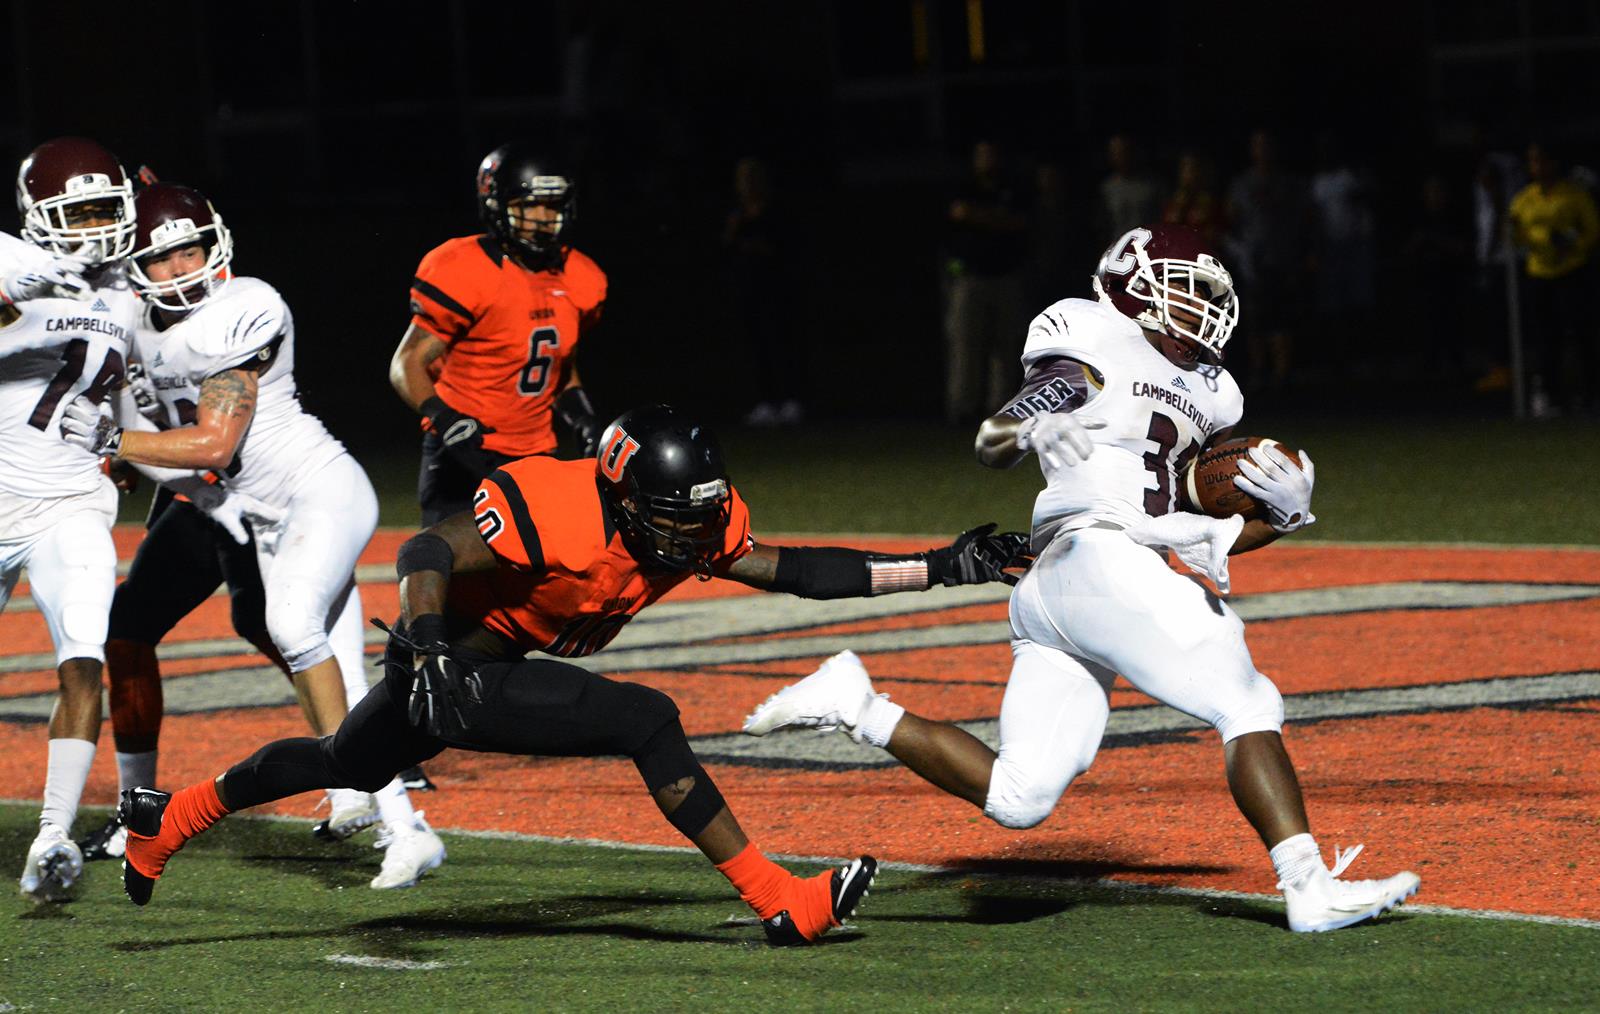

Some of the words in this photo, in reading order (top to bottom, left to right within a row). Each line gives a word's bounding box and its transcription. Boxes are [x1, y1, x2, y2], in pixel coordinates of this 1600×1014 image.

[1105, 227, 1152, 275] C
[516, 325, 559, 397] 6
[600, 425, 641, 483] U
